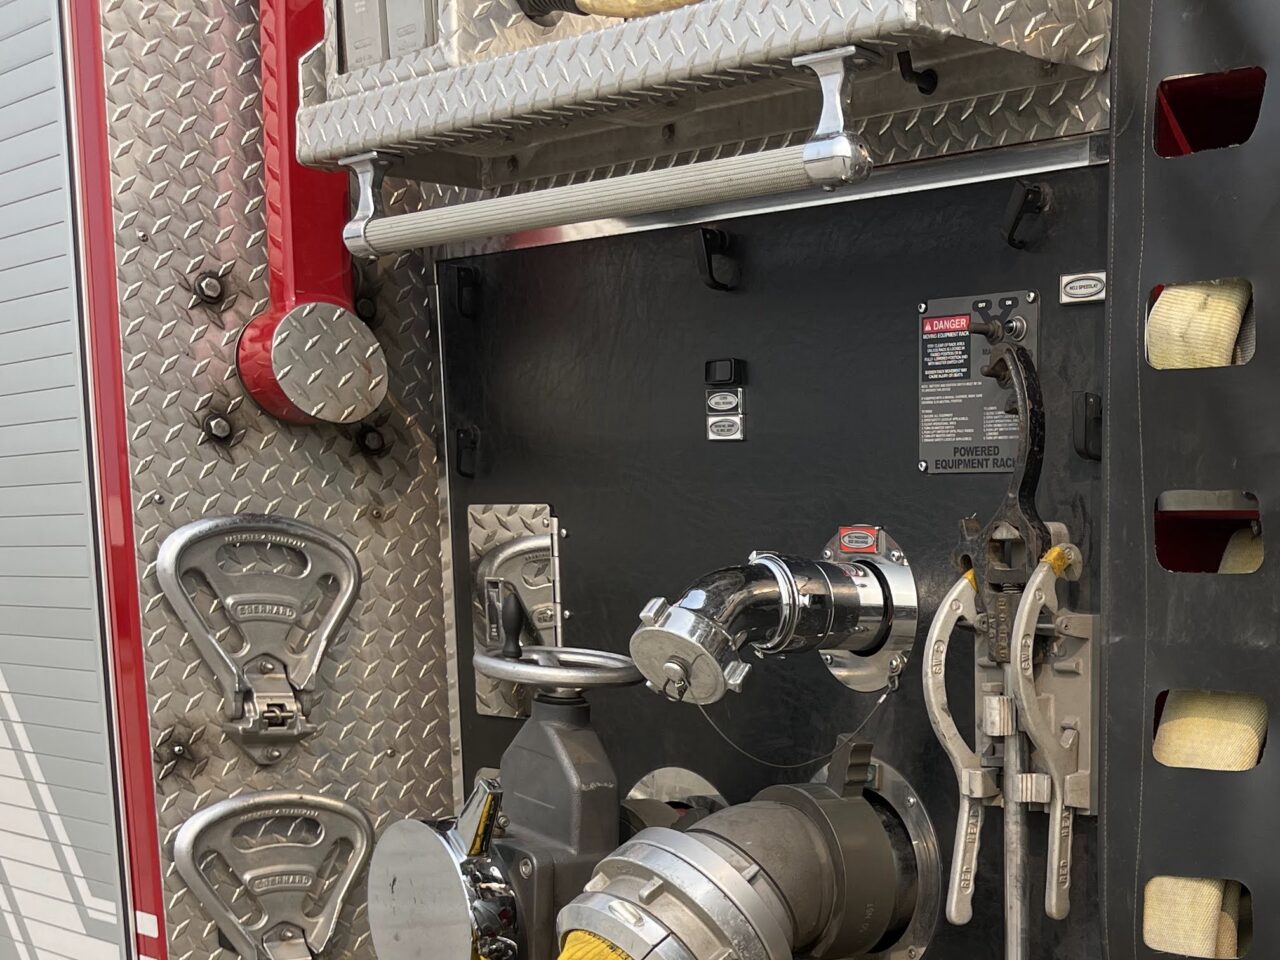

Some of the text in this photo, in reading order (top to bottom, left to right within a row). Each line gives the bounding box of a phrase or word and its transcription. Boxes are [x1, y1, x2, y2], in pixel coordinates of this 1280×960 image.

[933, 318, 966, 331] DANGER
[953, 446, 1000, 457] POWERED
[935, 458, 991, 470] EQUIPMENT
[239, 605, 293, 617] EBERHARD
[254, 875, 308, 890] EBERHARD
